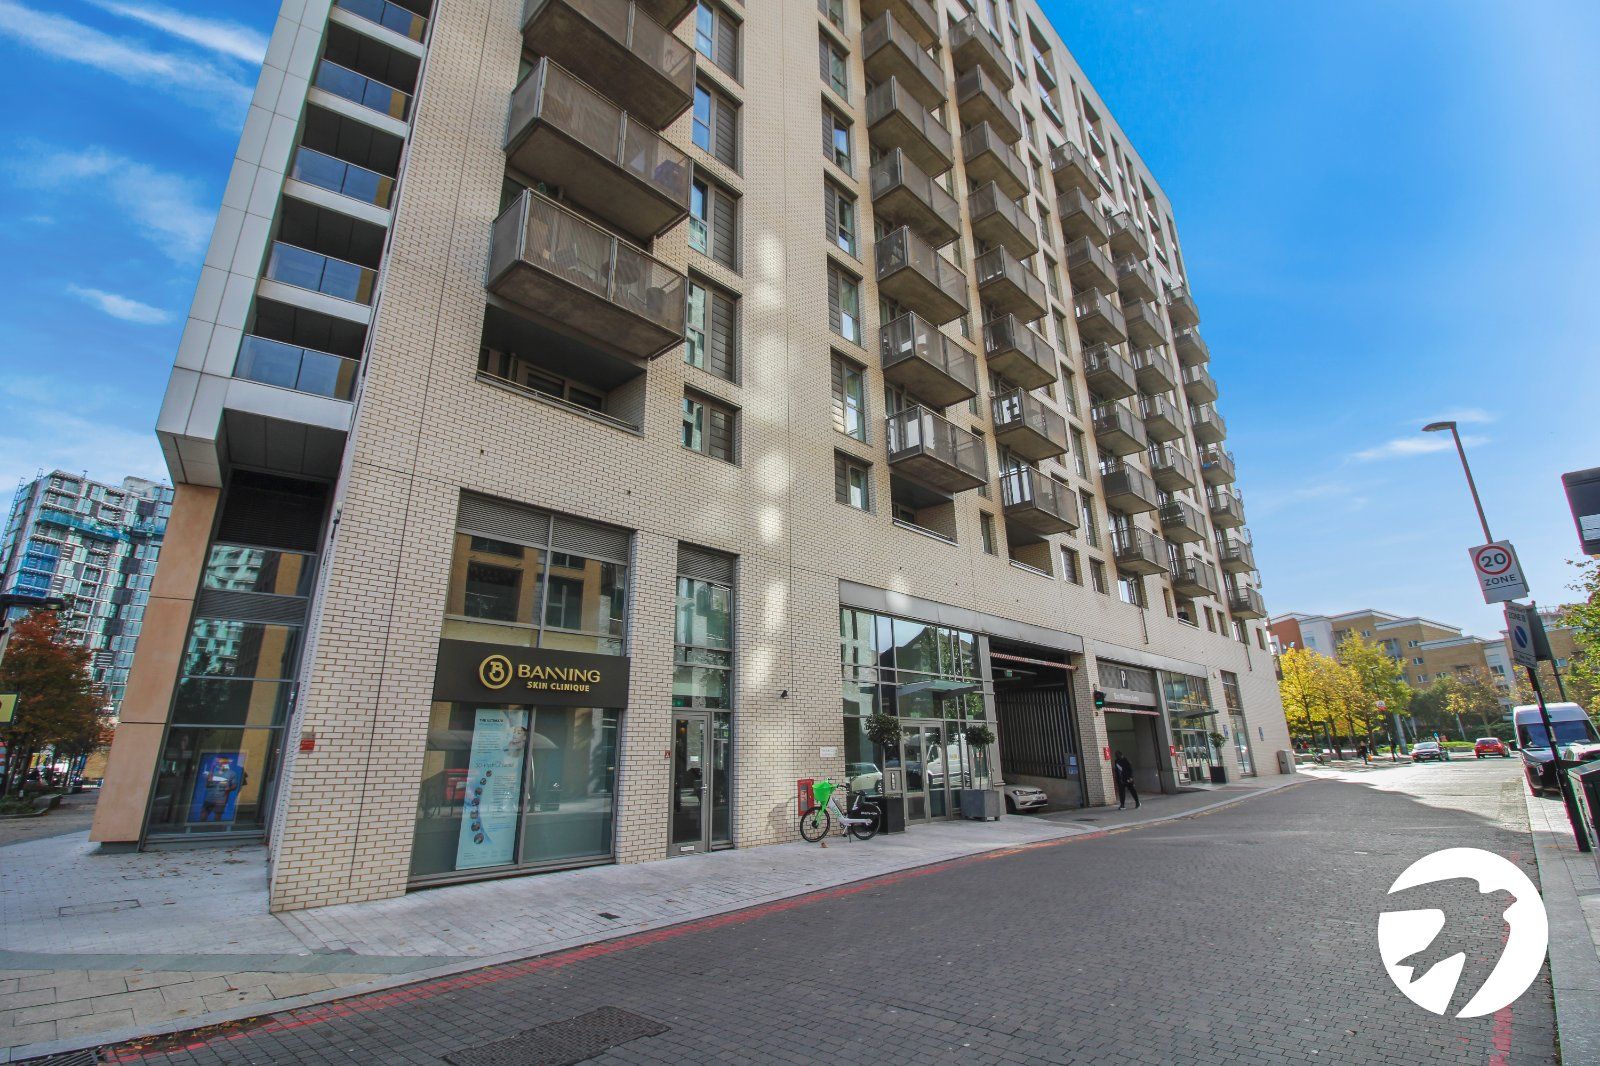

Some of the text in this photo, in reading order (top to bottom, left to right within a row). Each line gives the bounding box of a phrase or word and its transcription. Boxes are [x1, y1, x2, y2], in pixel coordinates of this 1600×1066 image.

[1481, 553, 1506, 568] 20
[1484, 574, 1517, 586] ZONE
[517, 664, 601, 683] BANNING
[1121, 670, 1126, 687] P
[526, 681, 590, 692] SKIN CLINIQUE
